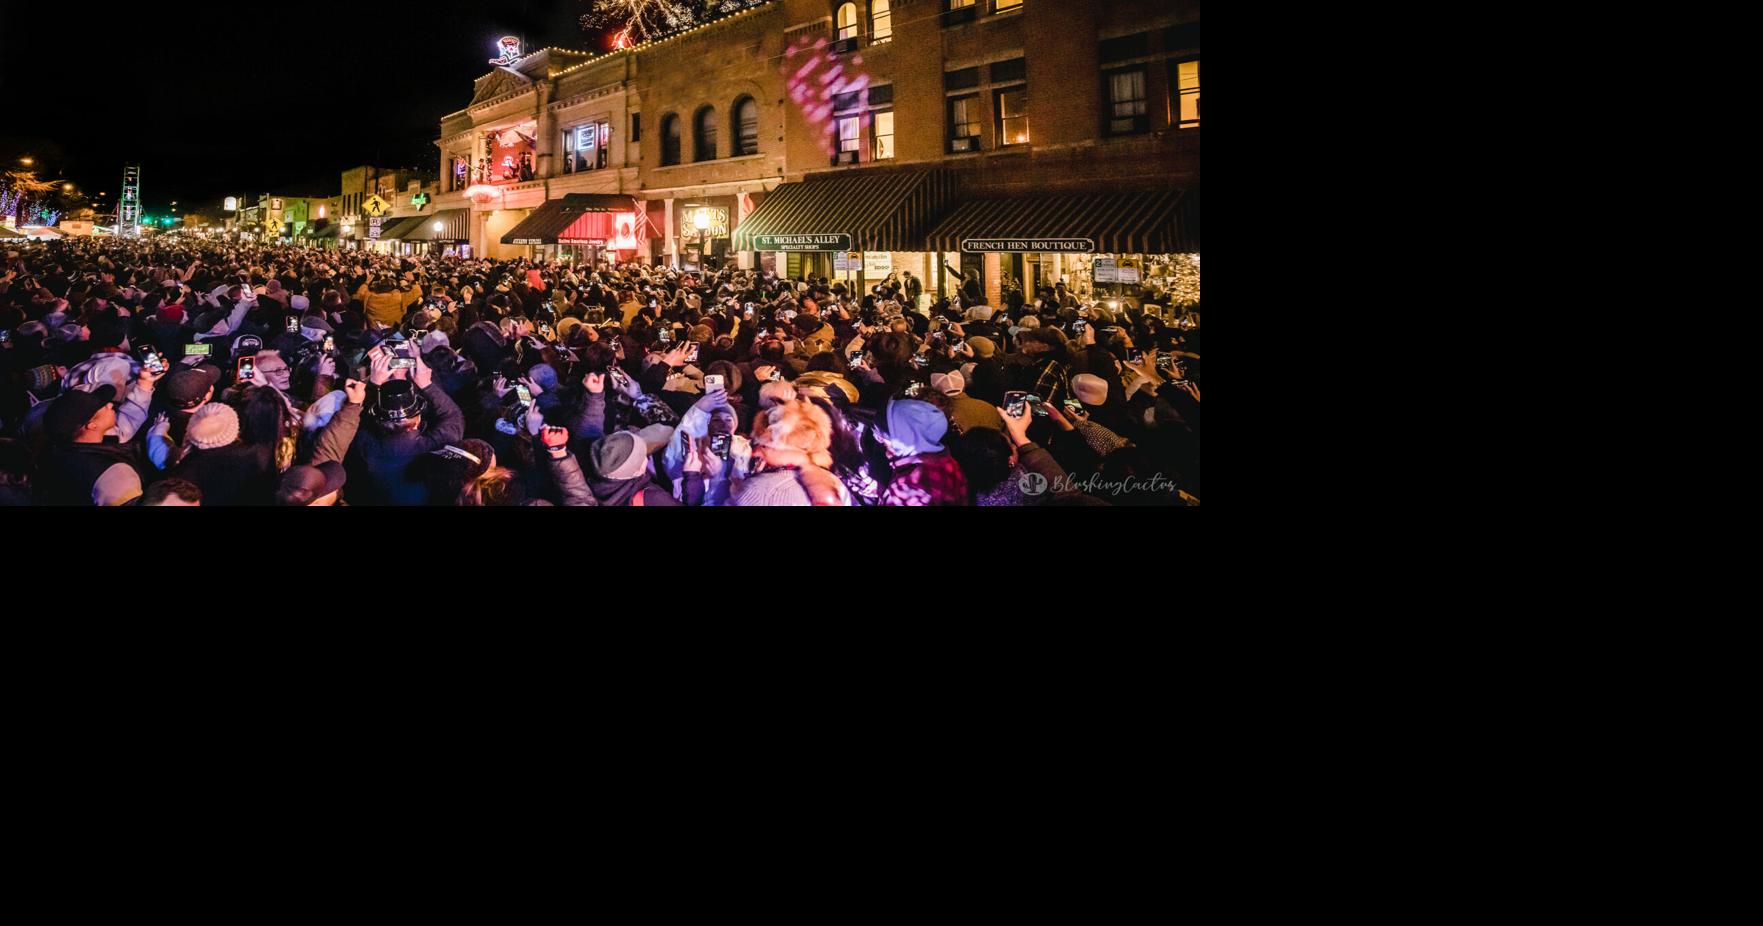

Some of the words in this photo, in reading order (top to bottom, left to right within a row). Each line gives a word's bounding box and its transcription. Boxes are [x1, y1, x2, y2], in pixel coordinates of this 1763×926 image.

[774, 236, 812, 244] MICHAEL'S
[967, 242, 1004, 250] FRENCH
[1007, 242, 1027, 250] HEN
[1031, 242, 1086, 250] BOUTIQUE
